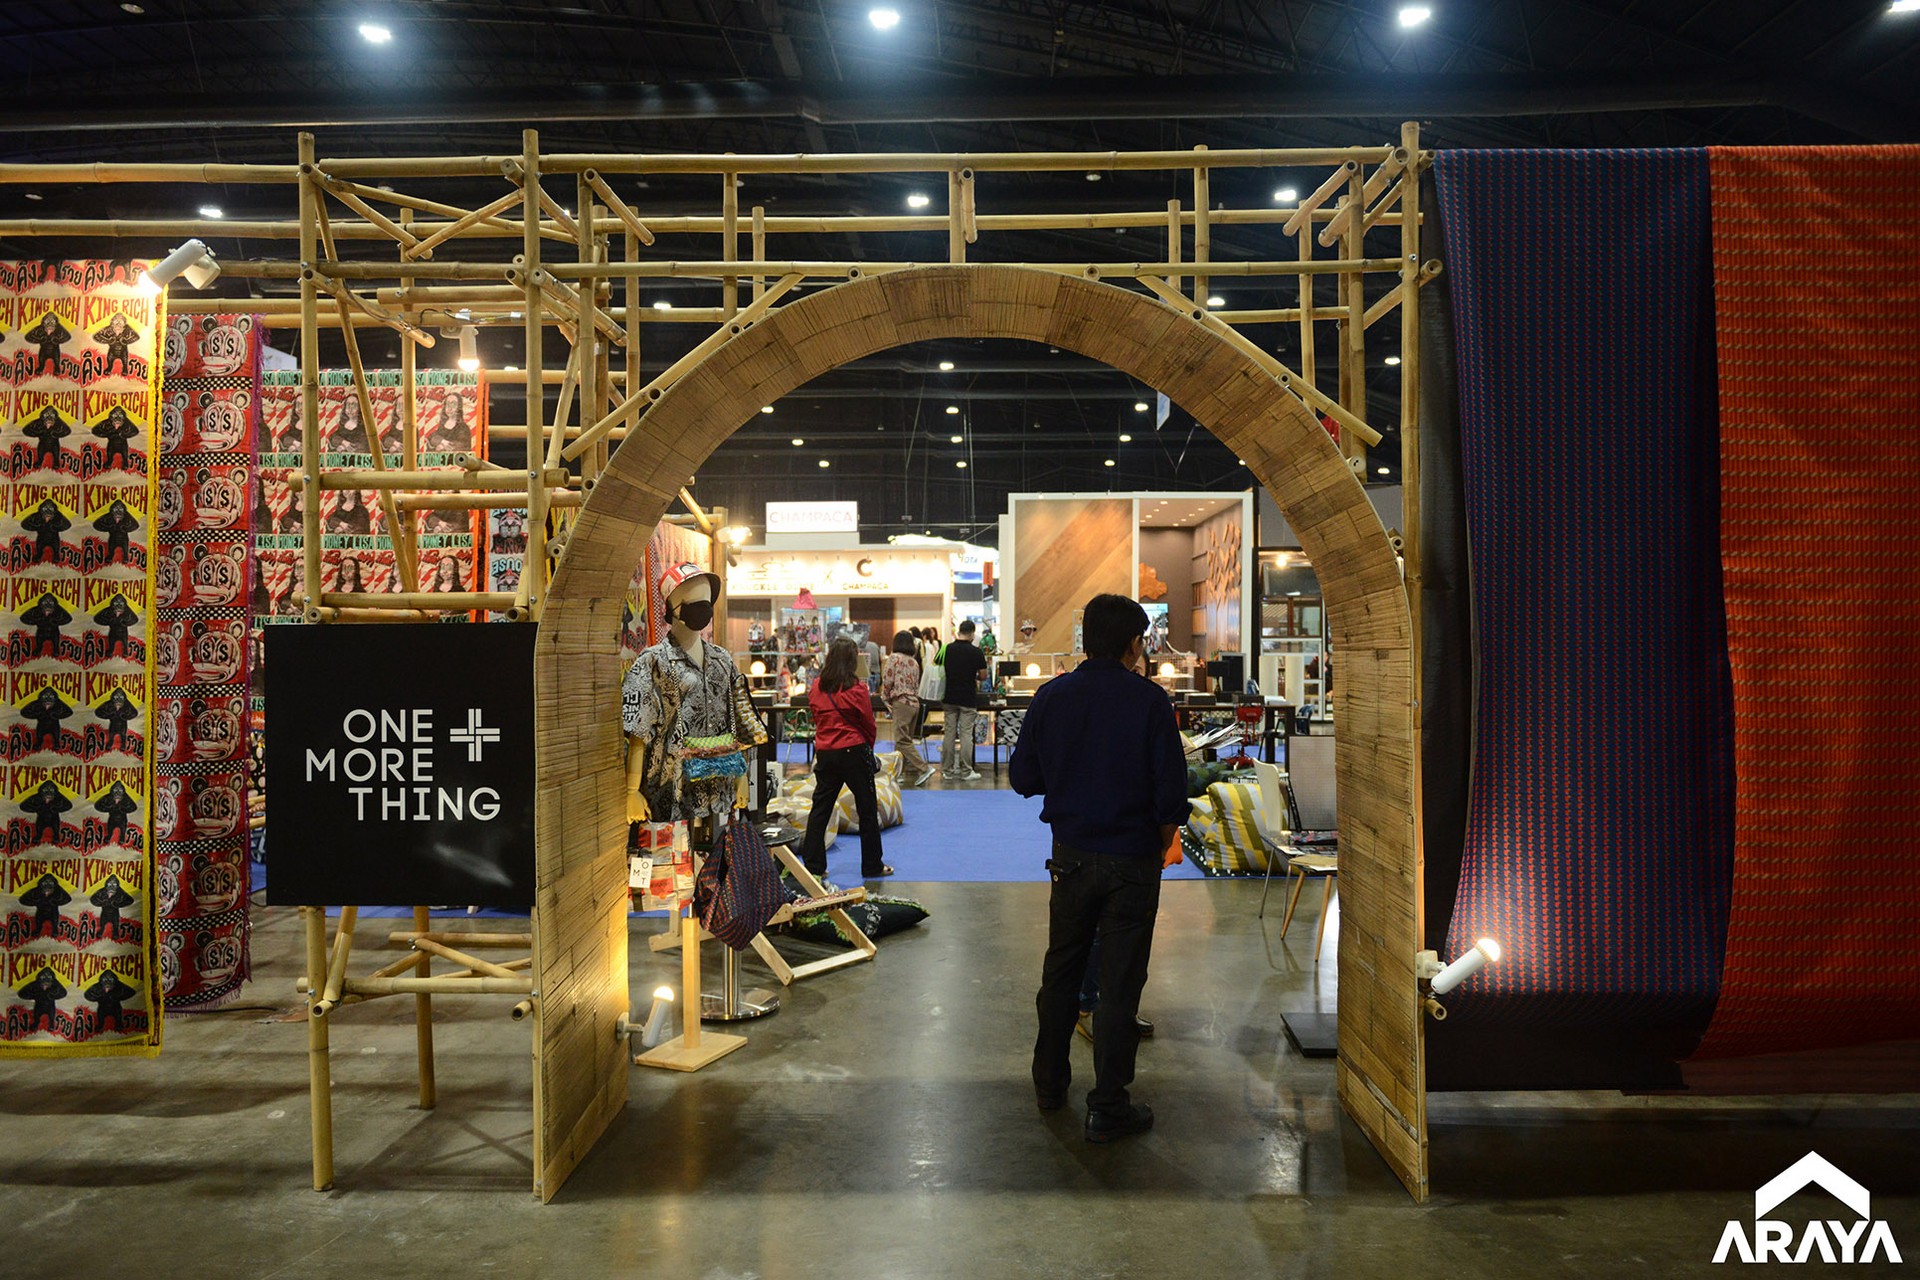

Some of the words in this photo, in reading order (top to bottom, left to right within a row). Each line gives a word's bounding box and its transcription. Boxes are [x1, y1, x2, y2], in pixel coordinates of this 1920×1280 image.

[18, 297, 50, 331] KING
[54, 297, 80, 326] RICH
[84, 297, 118, 330] KING
[122, 298, 148, 326] RICH
[14, 390, 48, 424] KING
[53, 390, 80, 420] RICH
[83, 390, 116, 424] KING
[121, 391, 148, 420] RICH
[12, 484, 48, 518] KING
[52, 484, 80, 514] RICH
[84, 484, 117, 518] KING
[121, 485, 148, 514] RICH
[770, 511, 852, 524] CHAMPACA
[452, 534, 473, 548] LISA
[11, 578, 48, 612] KING
[52, 578, 80, 608] RICH
[84, 578, 118, 612] KING
[122, 579, 146, 609] RICH
[11, 672, 48, 706] KING
[52, 672, 82, 702] RICH
[86, 672, 118, 706] KING
[122, 672, 146, 703] RICH
[343, 708, 433, 743] ONE
[306, 748, 434, 782] MORE
[10, 766, 48, 800] KING
[52, 766, 82, 795] RICH
[86, 766, 118, 800] KING
[120, 766, 144, 797] RICH
[348, 787, 500, 821] THING
[10, 858, 48, 893] KING
[52, 858, 80, 888] RICH
[83, 858, 112, 892] KING
[116, 860, 143, 890] RICH
[8, 953, 46, 988] KING
[50, 953, 76, 982] RICH
[77, 953, 106, 988] KING
[111, 953, 144, 982] RICH
